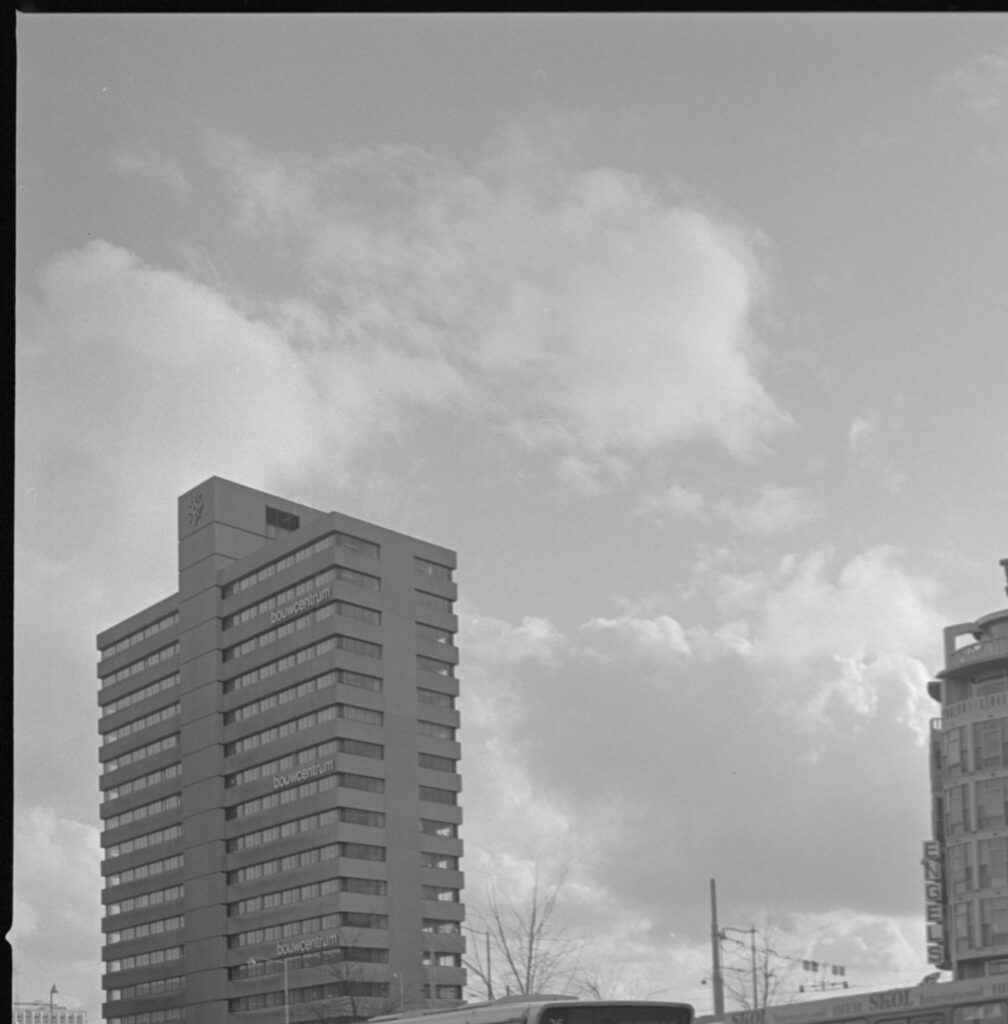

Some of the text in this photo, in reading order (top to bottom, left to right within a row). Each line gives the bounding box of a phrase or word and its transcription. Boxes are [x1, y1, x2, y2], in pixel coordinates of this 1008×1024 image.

[271, 587, 331, 624] bouwcentrum
[273, 760, 335, 789] bouwcentrum
[923, 841, 942, 964] ENGELS
[276, 934, 338, 956] bouwcentrum
[868, 989, 914, 1011] SKOL
